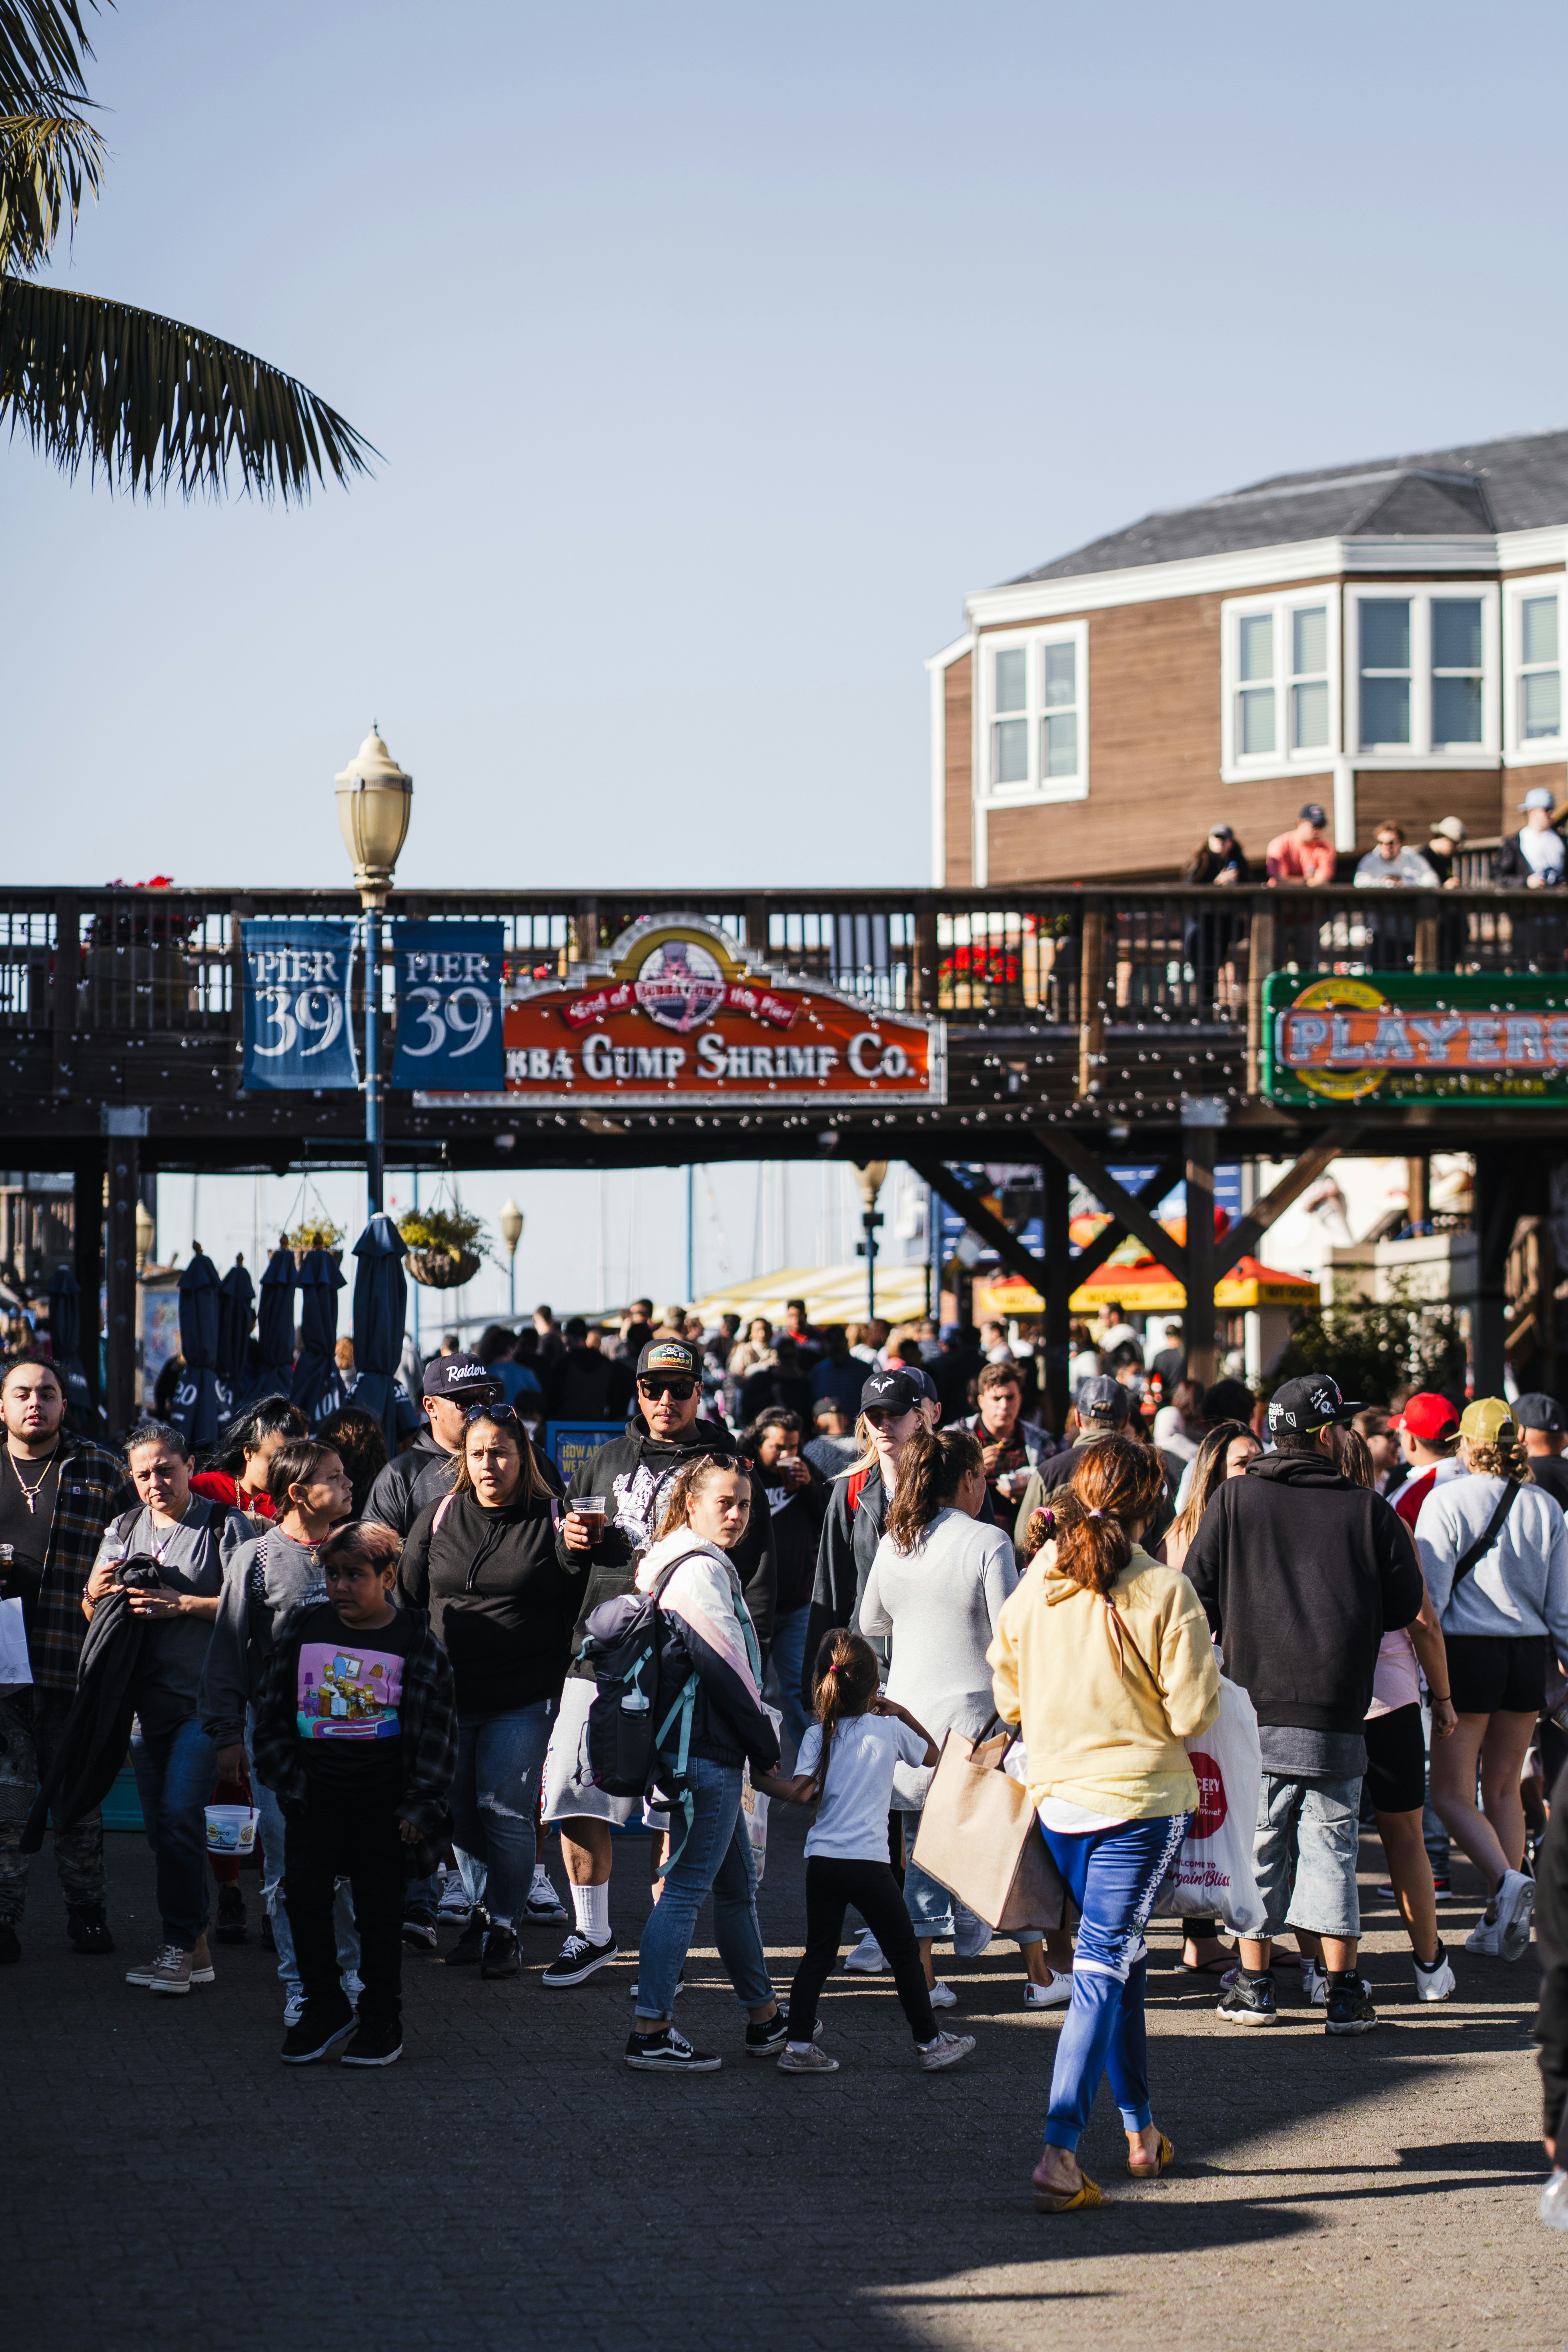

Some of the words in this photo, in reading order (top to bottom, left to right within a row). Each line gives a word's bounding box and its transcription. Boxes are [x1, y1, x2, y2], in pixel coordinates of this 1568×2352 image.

[254, 951, 339, 982] PIER
[405, 952, 490, 983] PIER
[254, 985, 343, 1057] 39
[402, 986, 493, 1058] 39
[505, 1048, 574, 1079] BBA
[582, 1032, 687, 1080] GUMP
[697, 1032, 838, 1080] SHRIMP
[446, 1364, 487, 1382] Raiders
[562, 1445, 585, 1458] HOW
[586, 1445, 600, 1458] AR
[562, 1460, 577, 1473] WE
